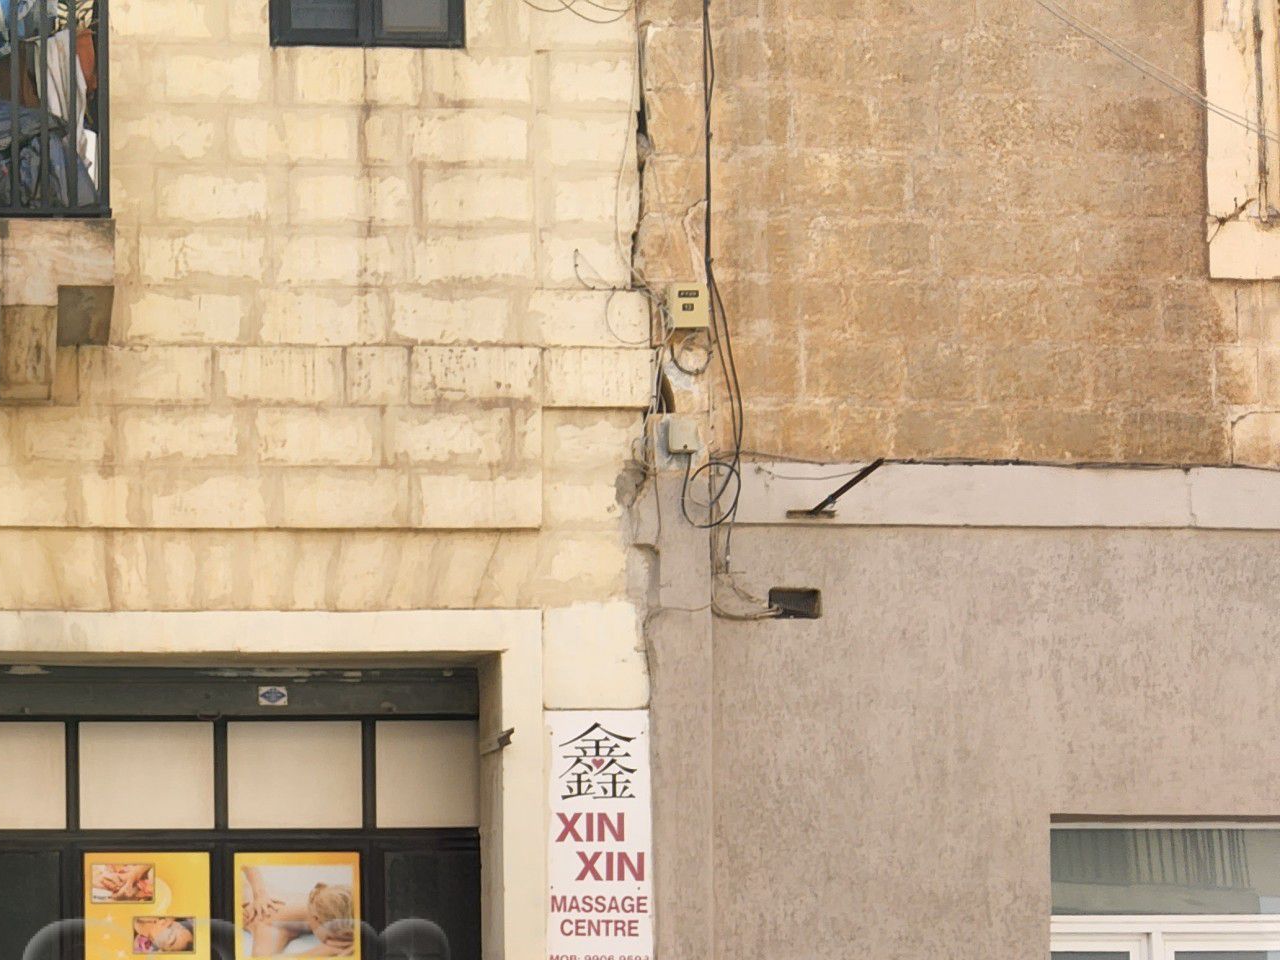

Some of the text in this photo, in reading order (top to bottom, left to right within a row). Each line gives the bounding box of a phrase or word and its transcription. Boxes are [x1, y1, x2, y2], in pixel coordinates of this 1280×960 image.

[558, 722, 637, 800] 鑫
[555, 812, 625, 842] XIN
[575, 851, 645, 882] XIN
[550, 895, 648, 913] MASSAGE
[560, 919, 639, 937] CENTRE
